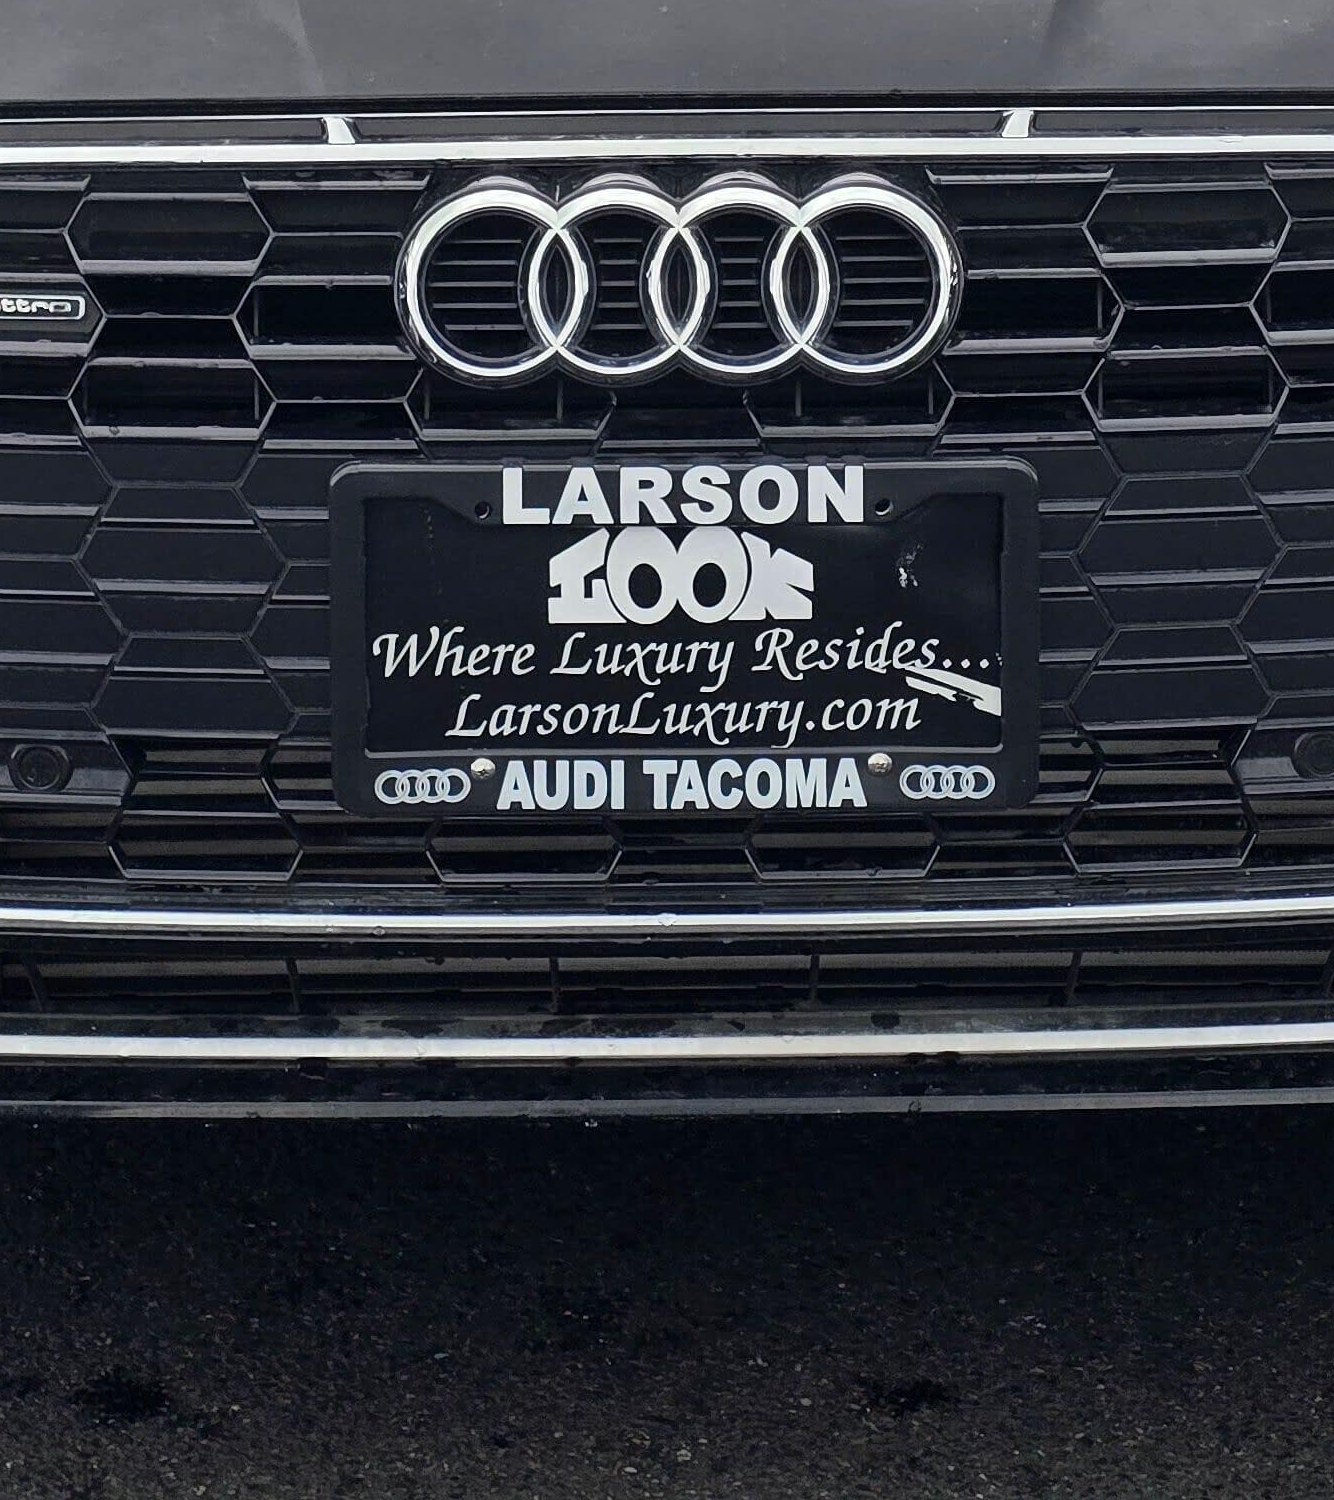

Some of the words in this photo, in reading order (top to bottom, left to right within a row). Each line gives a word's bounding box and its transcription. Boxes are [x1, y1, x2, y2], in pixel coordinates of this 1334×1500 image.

[503, 465, 863, 524] LARSON
[373, 626, 535, 677] Where
[550, 632, 734, 692] Luxury
[752, 621, 989, 680] Resides...
[445, 692, 921, 748] LarsonLuxury.com
[497, 759, 624, 810] AUDI
[643, 758, 867, 809] TACOMA
